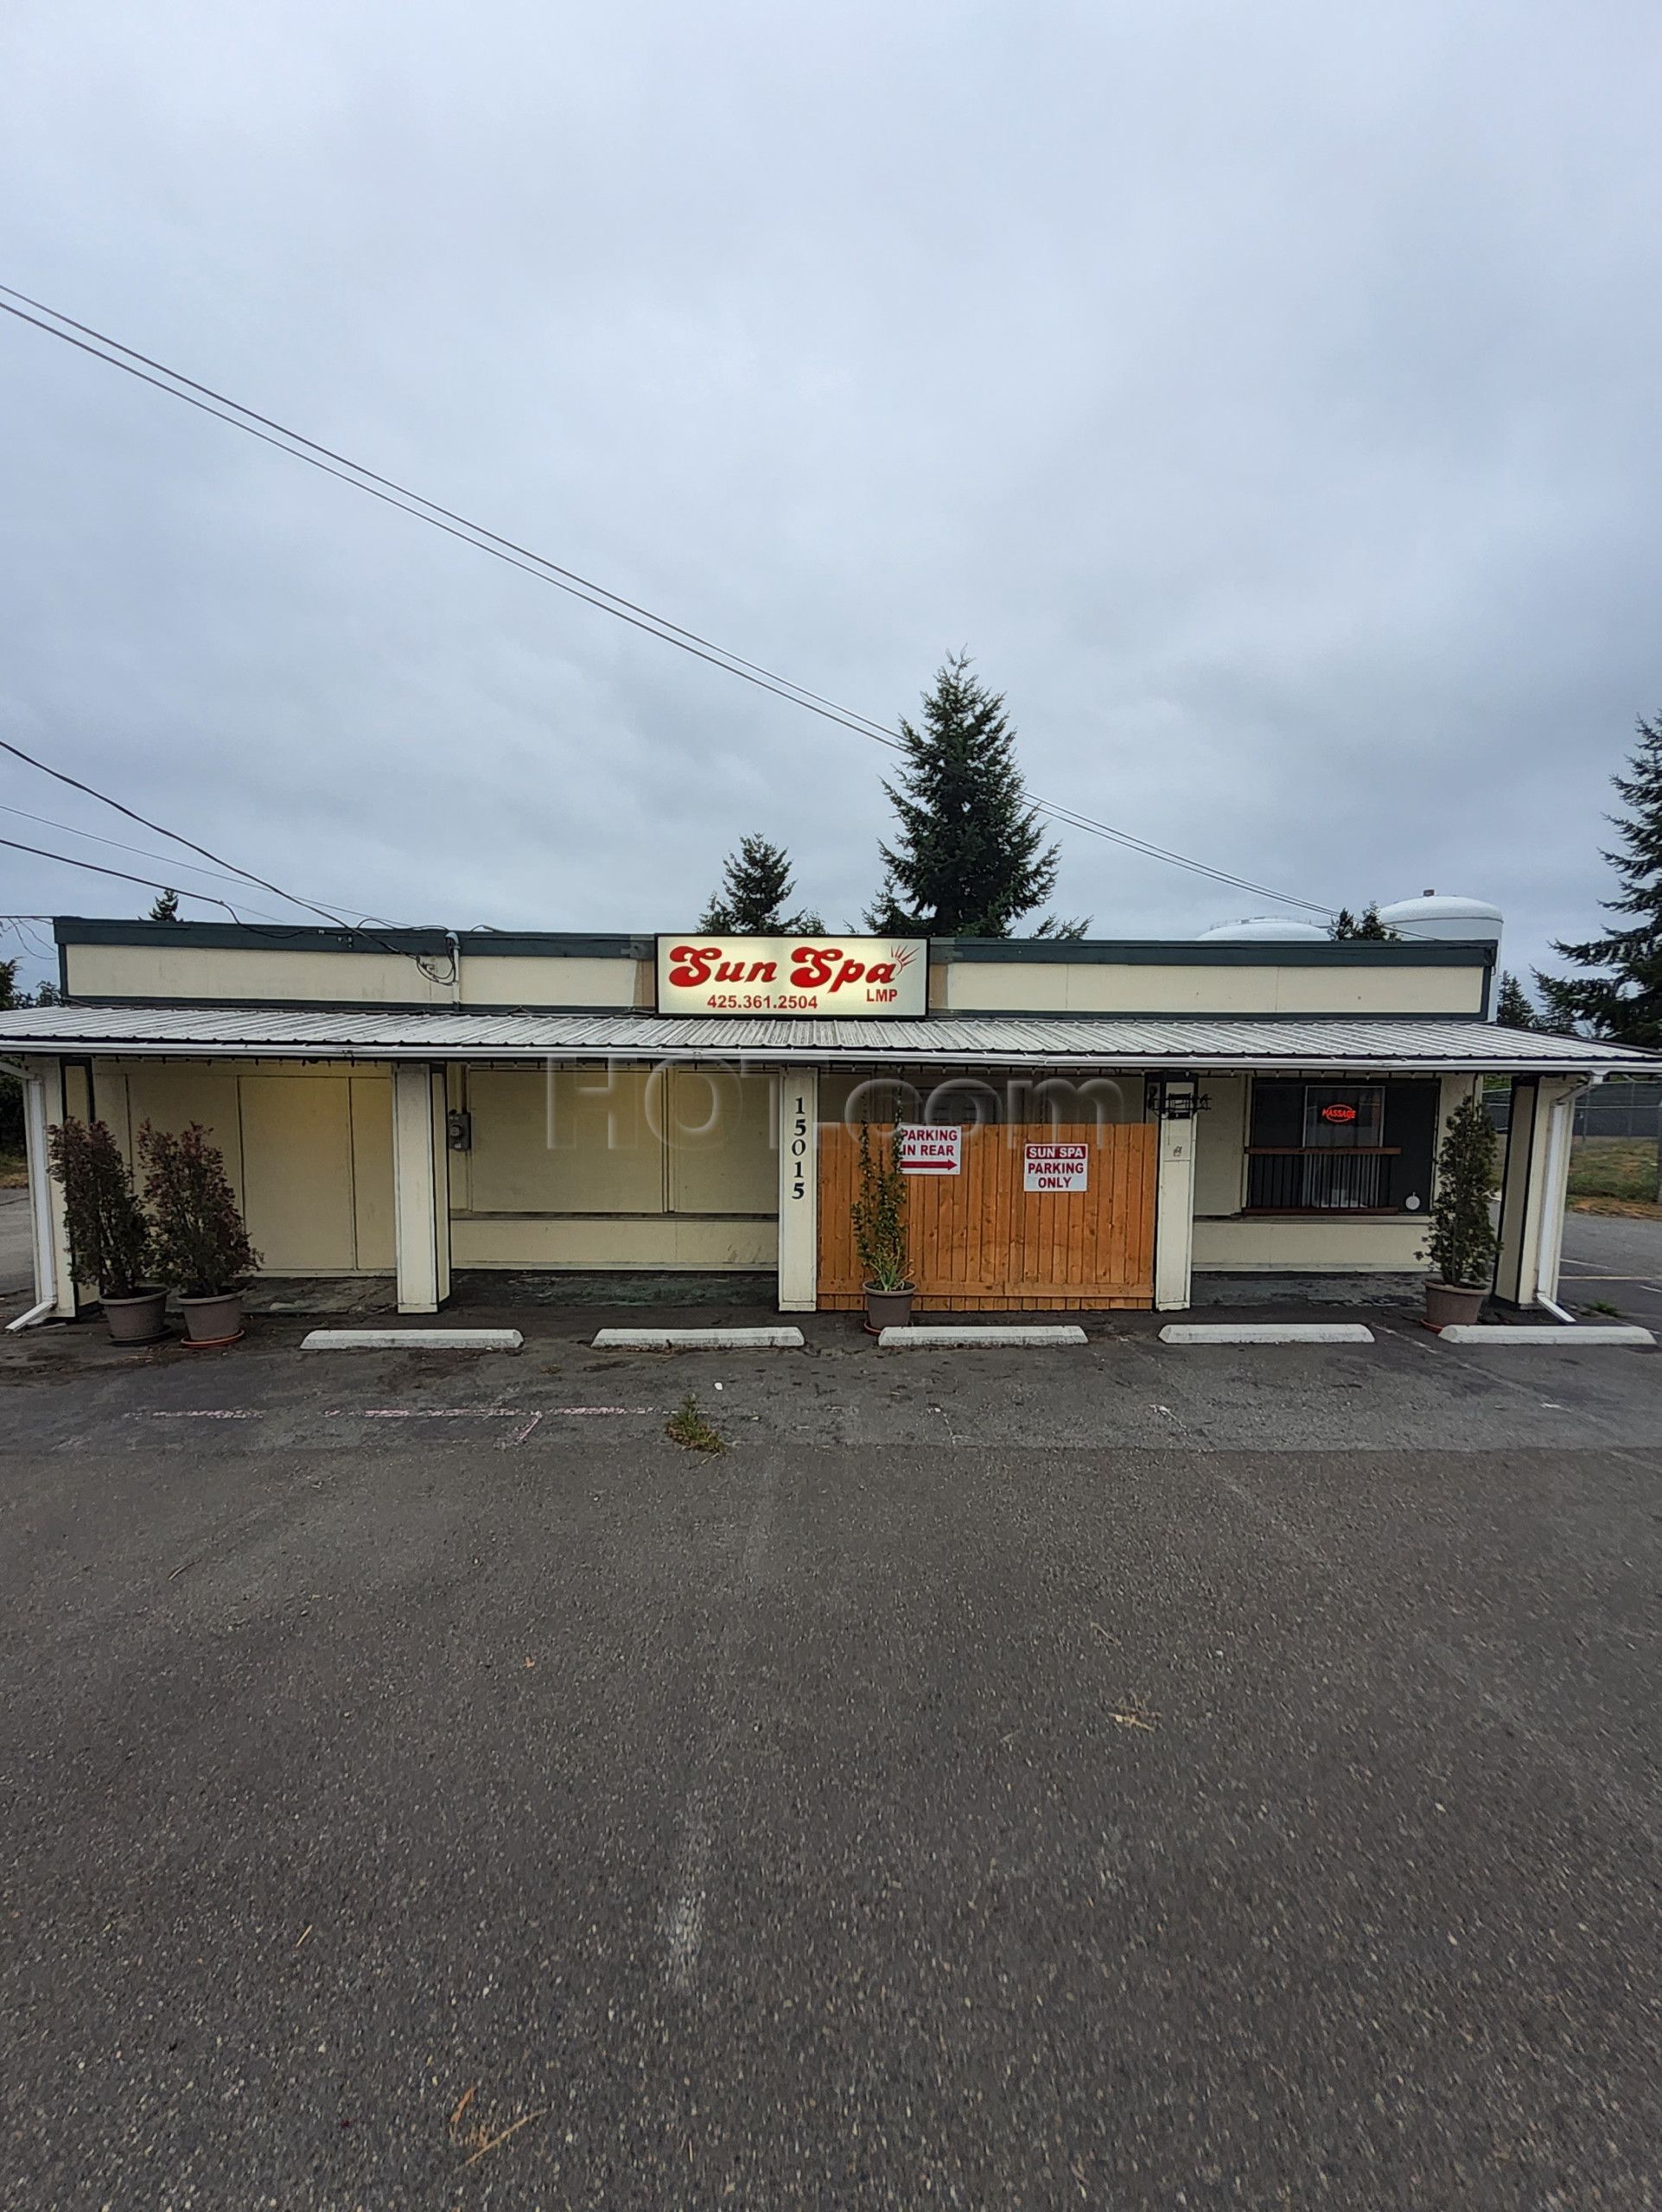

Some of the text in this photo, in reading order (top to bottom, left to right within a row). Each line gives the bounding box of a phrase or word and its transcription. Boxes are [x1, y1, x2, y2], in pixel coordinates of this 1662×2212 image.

[669, 945, 896, 994] Sun Spa
[866, 988, 898, 1002] LMP
[706, 995, 818, 1009] 425.361.2504
[1322, 1108, 1356, 1119] MASSAGE
[900, 1128, 958, 1141] PARKING
[791, 1096, 806, 1200] 15015
[901, 1144, 954, 1156] IN REAR
[1028, 1147, 1084, 1158] SUN SPA
[1028, 1162, 1084, 1174] PARKING
[1038, 1176, 1072, 1188] ONLY
